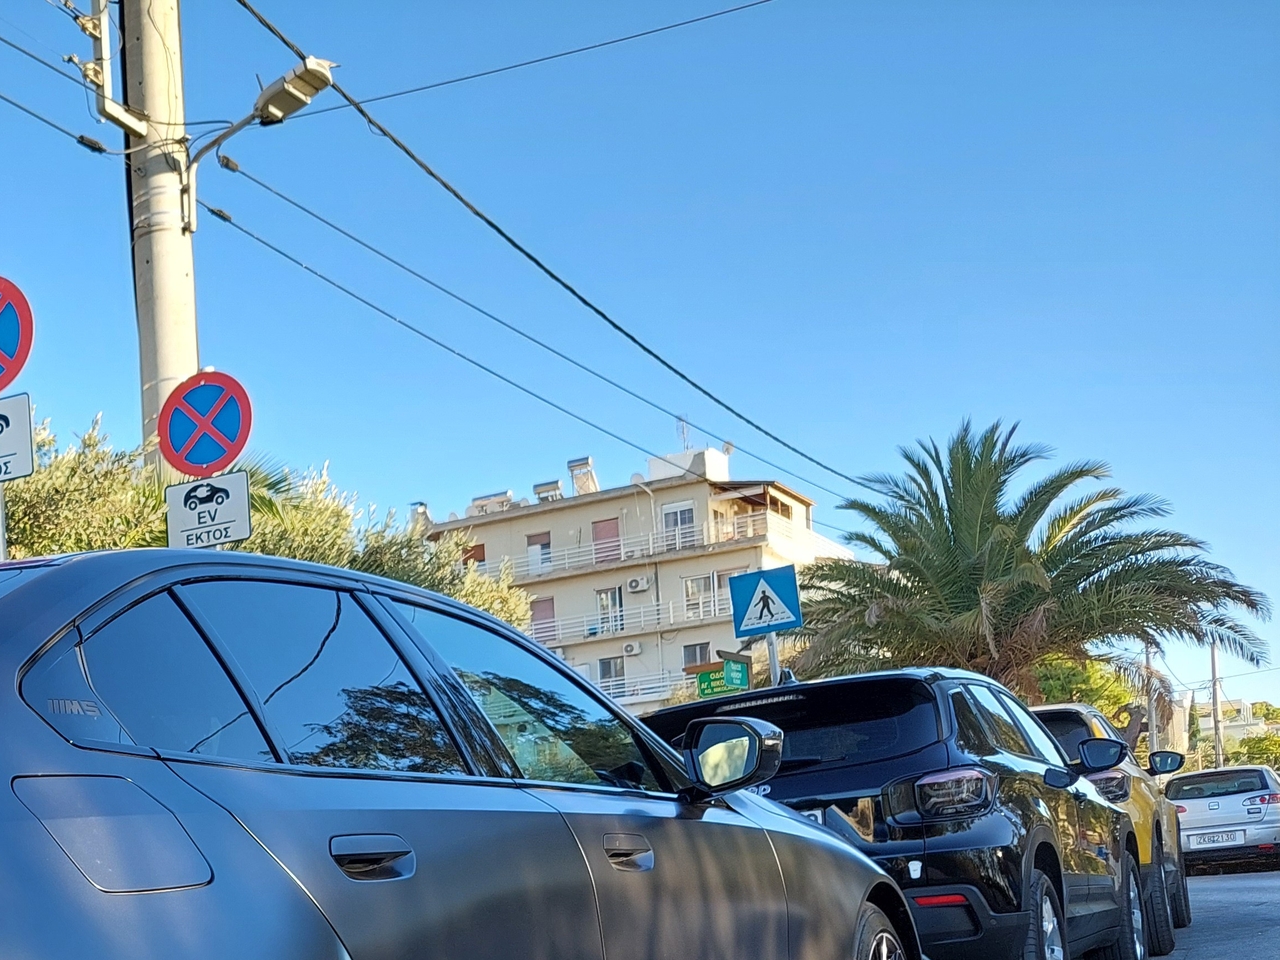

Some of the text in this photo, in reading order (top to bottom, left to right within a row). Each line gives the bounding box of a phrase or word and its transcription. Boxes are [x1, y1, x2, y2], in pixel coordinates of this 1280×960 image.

[197, 509, 218, 525] EV
[186, 527, 232, 547] ΕΚΤΟΣ
[710, 671, 725, 680] ΟΔΟ
